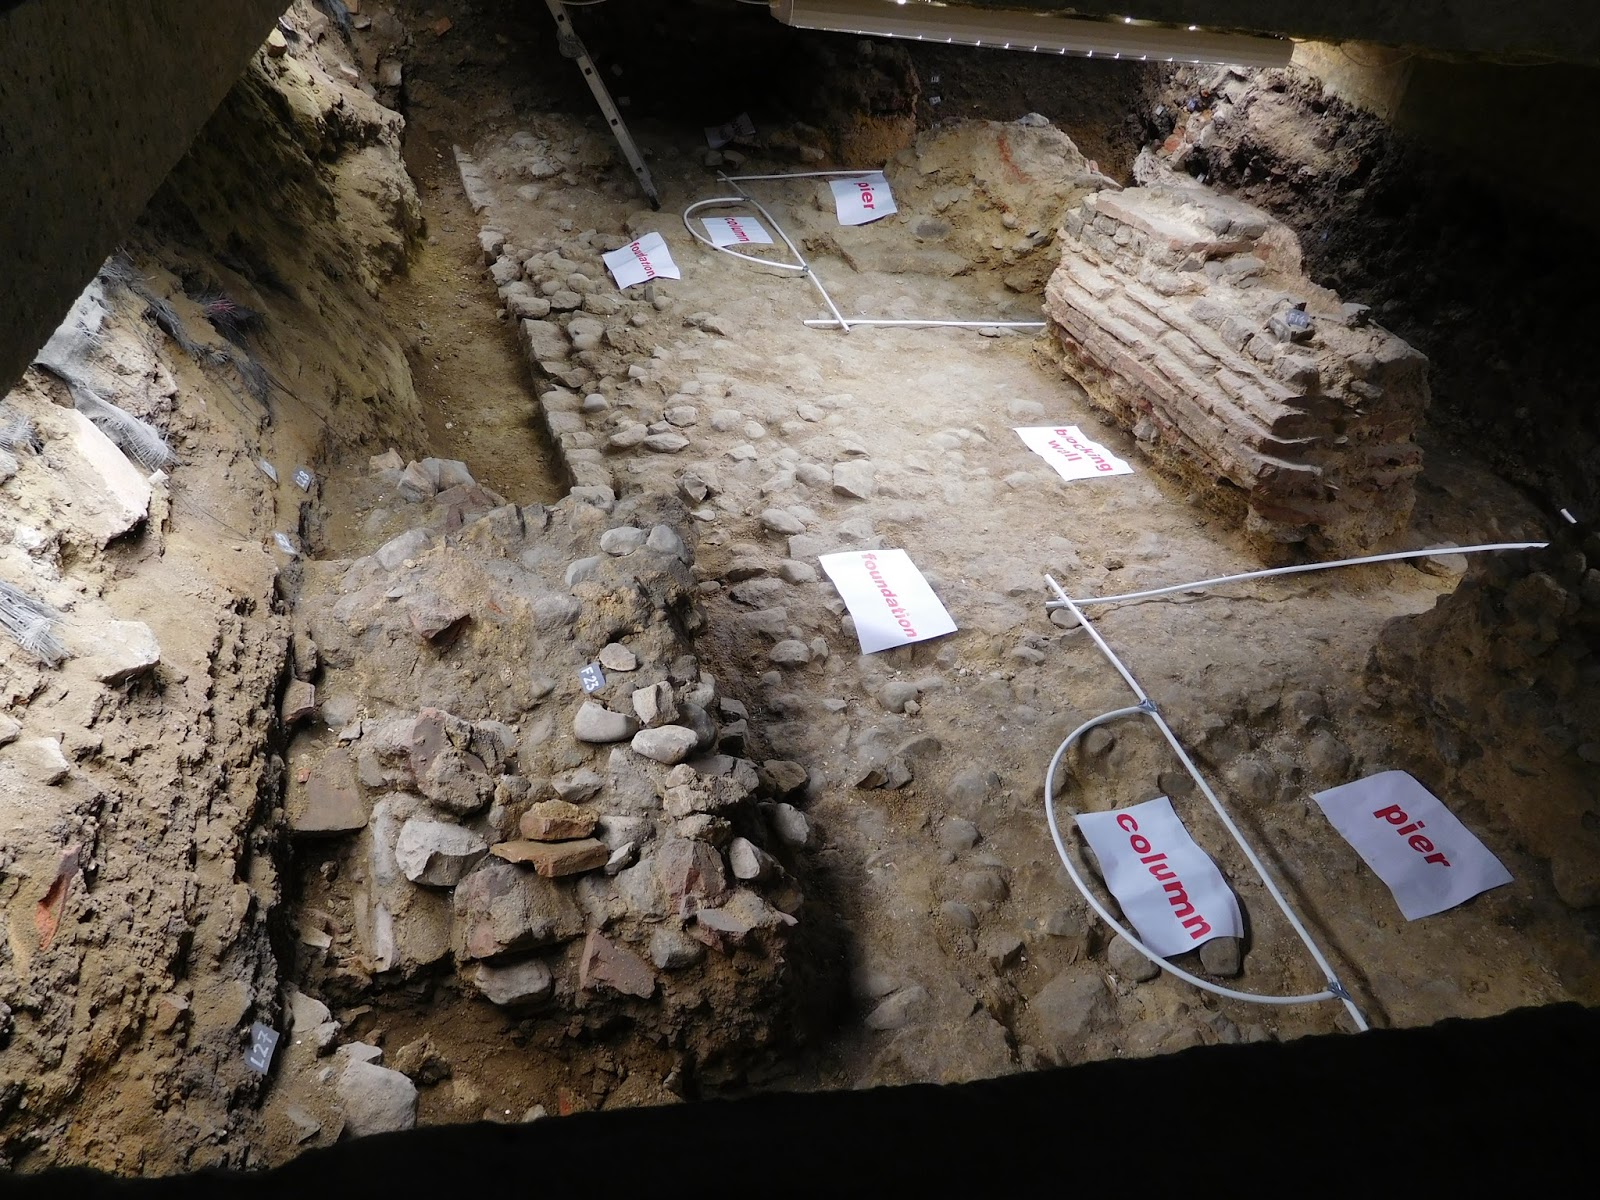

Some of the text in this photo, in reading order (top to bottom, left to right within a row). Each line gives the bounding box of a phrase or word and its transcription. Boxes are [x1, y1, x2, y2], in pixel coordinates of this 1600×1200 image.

[853, 183, 875, 209] pier
[724, 217, 750, 242] column
[1054, 429, 1114, 471] blocking
[861, 553, 918, 638] foundation
[580, 666, 599, 691] F23
[1373, 803, 1451, 868] pier
[1116, 812, 1212, 942] column
[250, 1030, 272, 1068] L27
